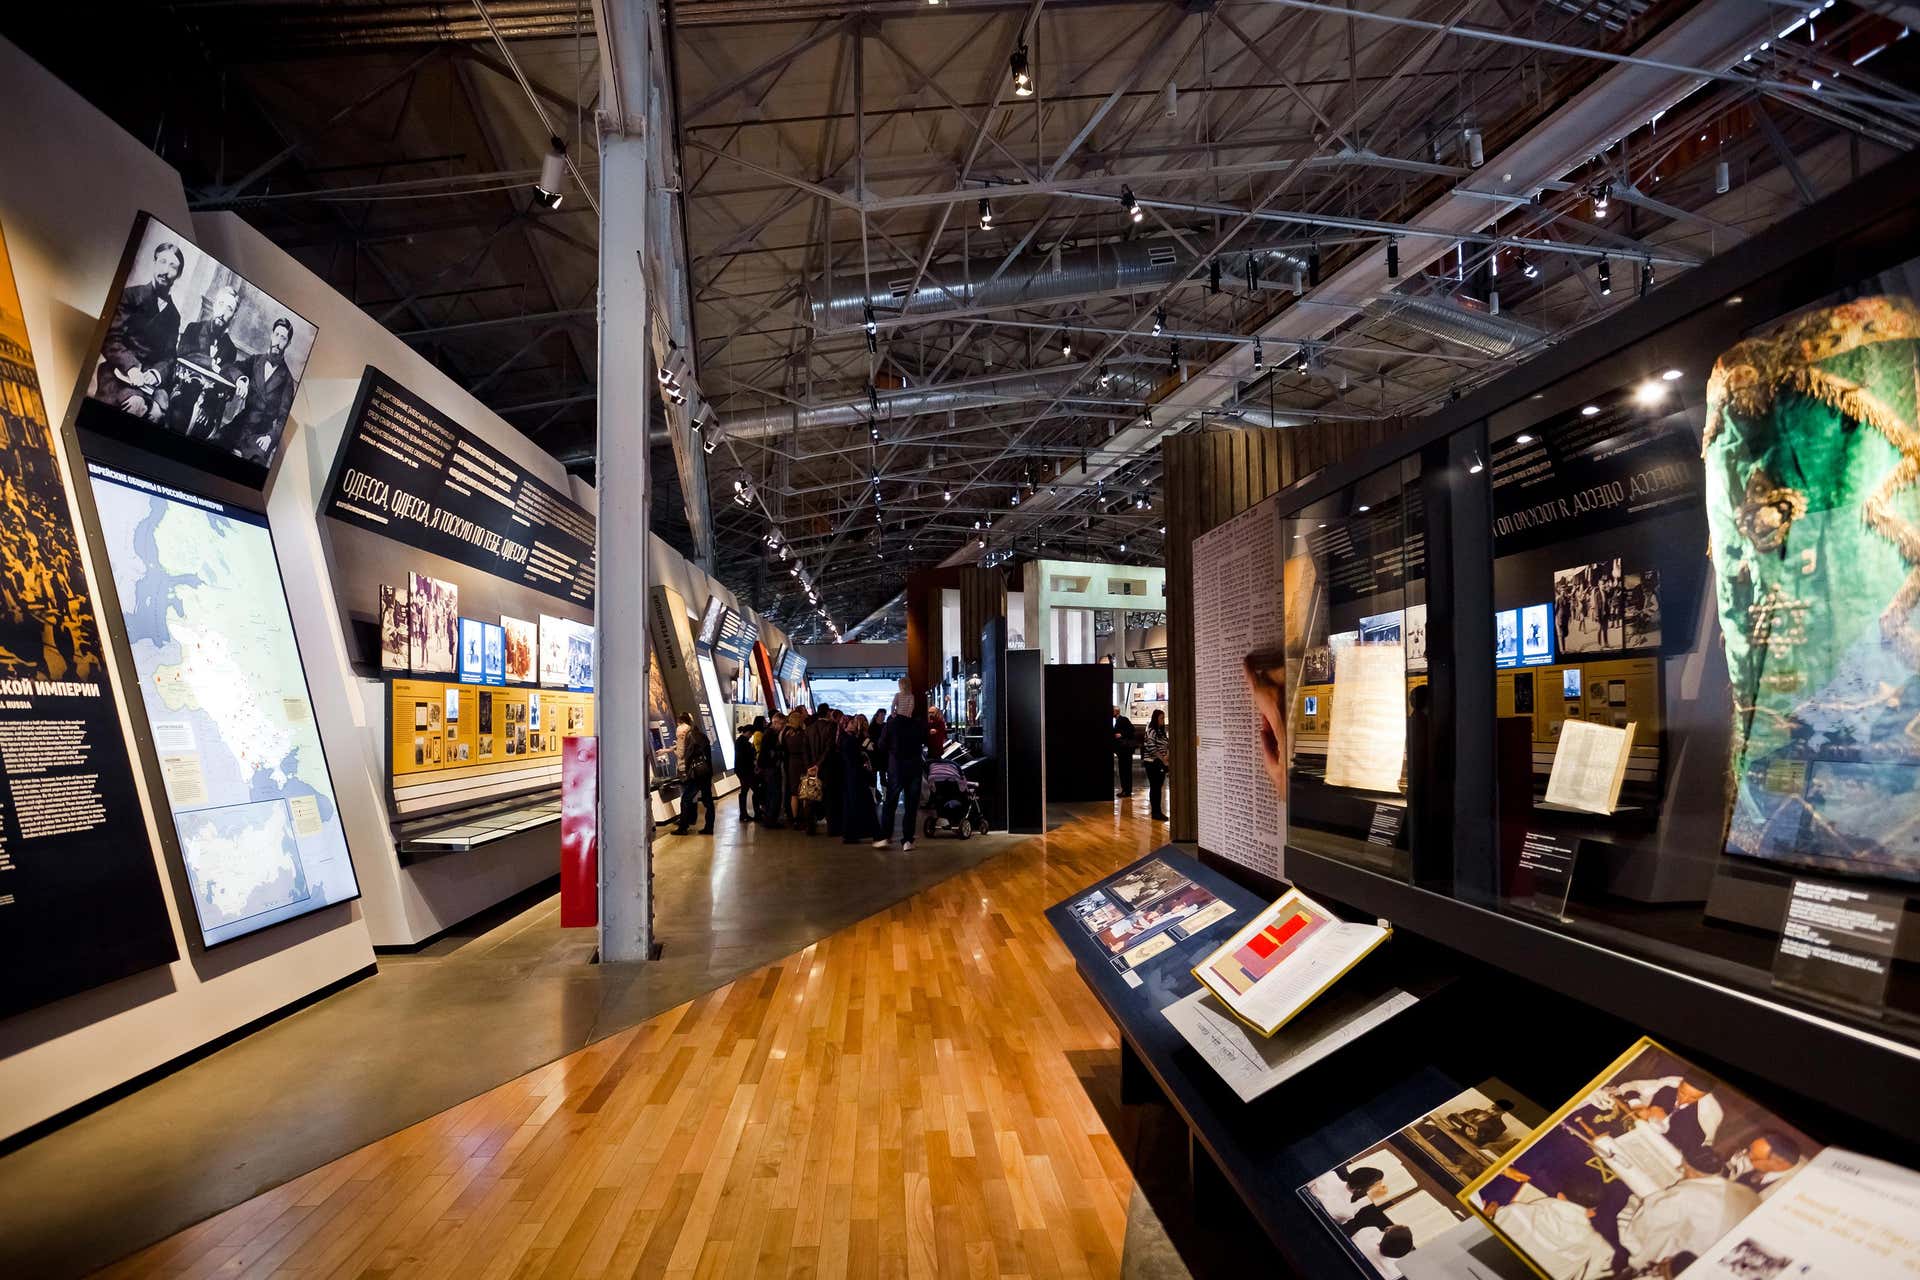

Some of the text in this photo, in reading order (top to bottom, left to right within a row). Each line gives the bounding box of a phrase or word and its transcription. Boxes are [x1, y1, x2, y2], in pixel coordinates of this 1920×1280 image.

[342, 468, 389, 512] ОДЕССА,
[391, 489, 430, 528] ОДЕССА,
[429, 507, 440, 529] Я
[441, 510, 474, 542] ТОСКУЮ
[471, 525, 485, 547] ПО
[483, 529, 503, 557] ТЕБЕ,
[0, 678, 100, 697] КОЙ ИМПЕРИИ
[6, 700, 32, 709] RUSSIA
